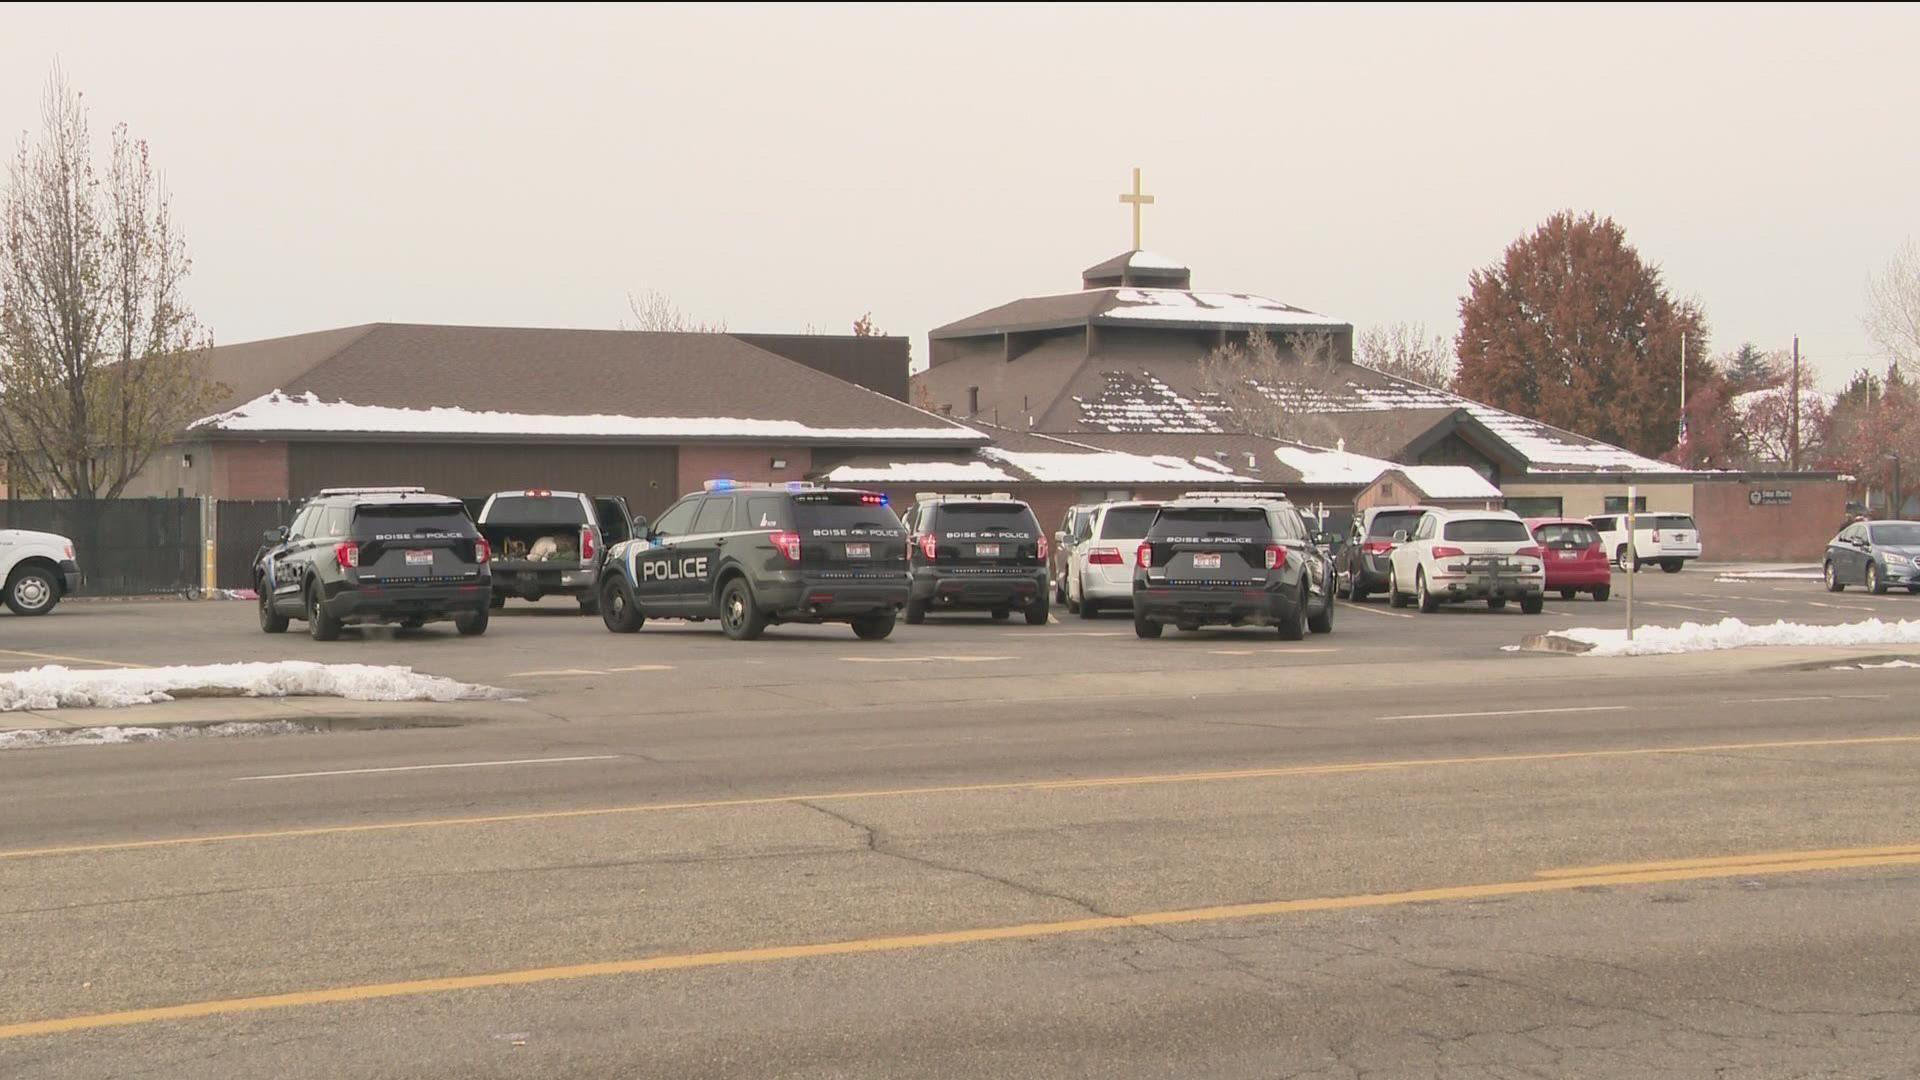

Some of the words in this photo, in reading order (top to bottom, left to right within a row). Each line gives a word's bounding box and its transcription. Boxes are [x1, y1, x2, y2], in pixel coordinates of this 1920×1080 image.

[813, 529, 847, 537] BOISE
[869, 529, 899, 537] POLICE
[643, 556, 708, 581] POLICE
